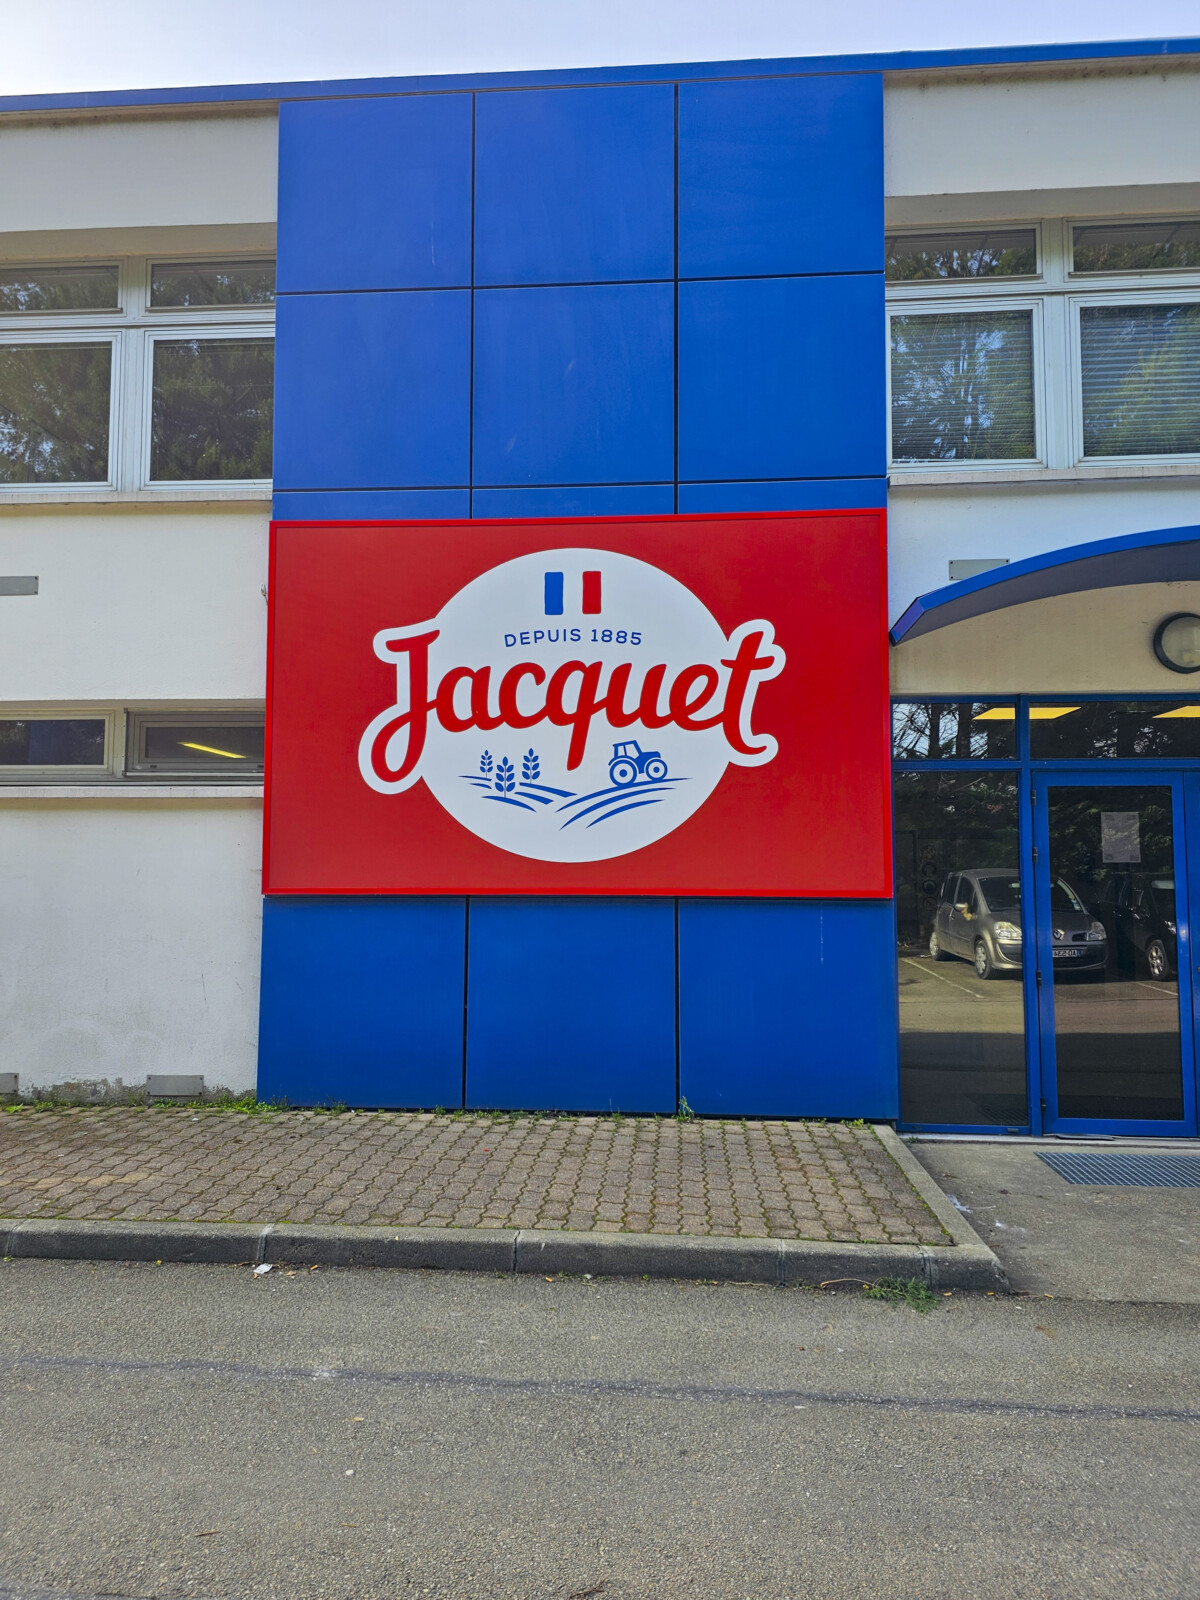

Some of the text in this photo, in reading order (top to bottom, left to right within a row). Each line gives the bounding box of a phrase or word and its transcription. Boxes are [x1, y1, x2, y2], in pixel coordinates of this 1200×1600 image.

[504, 628, 642, 648] DEPUIS 1885
[371, 630, 774, 783] Jacquet
